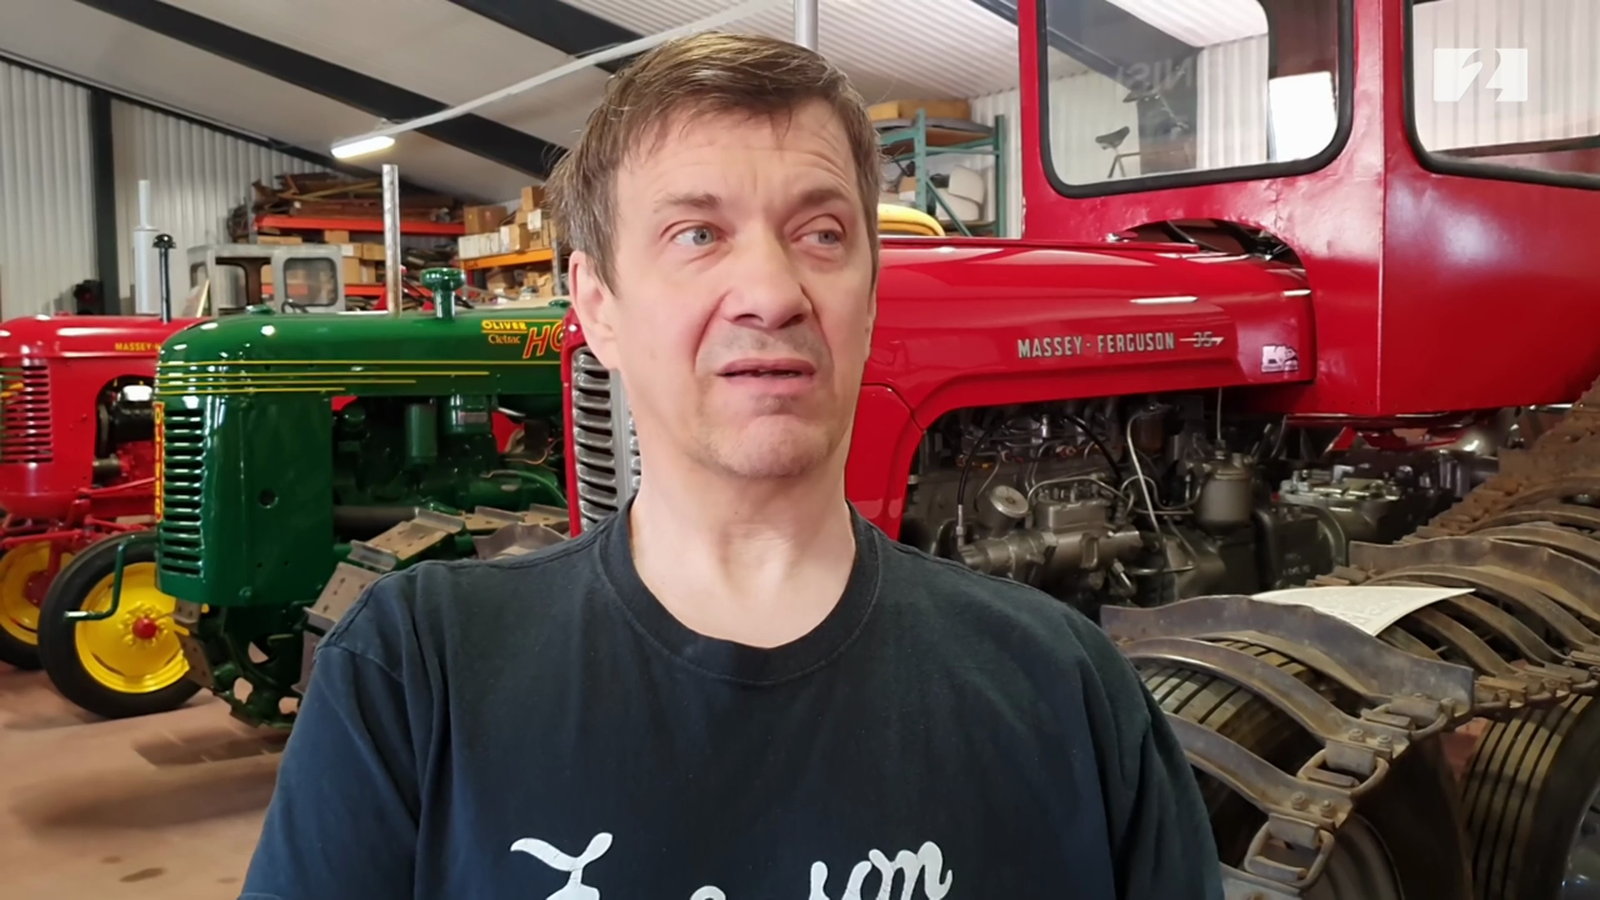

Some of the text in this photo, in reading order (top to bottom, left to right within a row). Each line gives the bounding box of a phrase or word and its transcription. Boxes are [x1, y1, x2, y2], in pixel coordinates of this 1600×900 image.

[481, 320, 527, 330] OLIVER
[1017, 336, 1082, 358] MASSEY
[1097, 332, 1175, 353] FERGUSON
